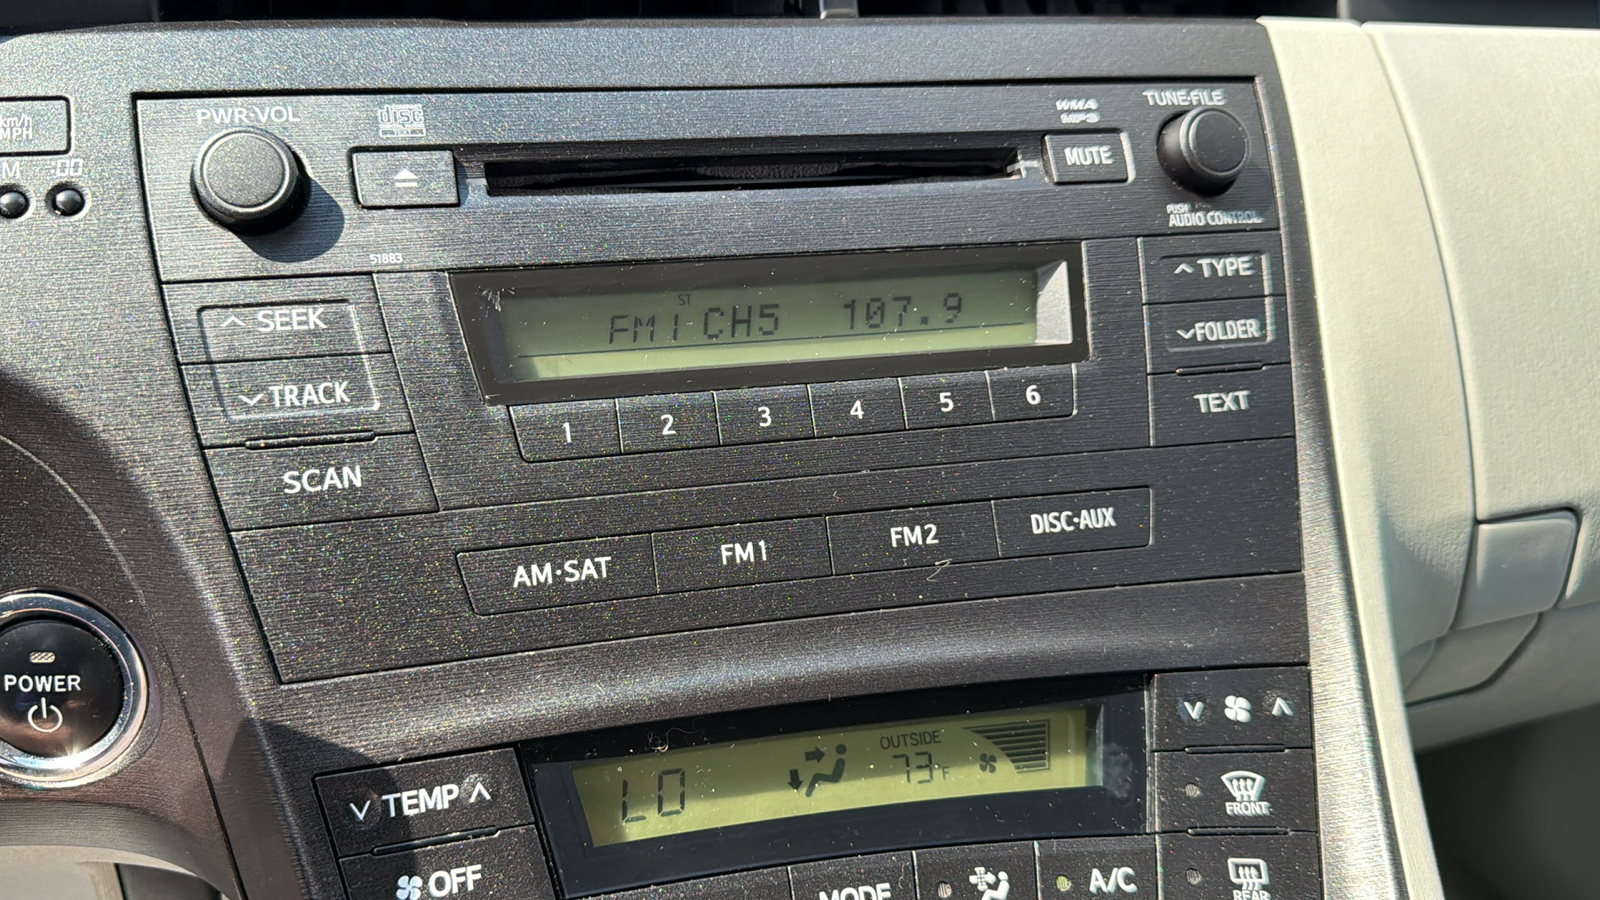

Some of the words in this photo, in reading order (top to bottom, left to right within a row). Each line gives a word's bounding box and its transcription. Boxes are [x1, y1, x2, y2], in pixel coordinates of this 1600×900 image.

[1064, 146, 1113, 165] MUTE
[1166, 203, 1191, 214] PUSH
[1169, 211, 1206, 227] AUDIO
[1207, 210, 1264, 225] CONTROL
[370, 252, 403, 263] 51883
[1197, 256, 1254, 277] TYPE
[678, 293, 692, 306] ST
[257, 307, 327, 331] SEEK
[703, 303, 780, 339] CH5
[1194, 319, 1261, 341] FOLDER
[269, 381, 350, 408] TRACK
[940, 392, 954, 412] 5
[1026, 386, 1041, 406] 6
[1193, 390, 1251, 413] TEXT
[757, 406, 772, 427] 3
[850, 399, 866, 420] 4
[562, 422, 573, 443] 1
[661, 414, 677, 435] 2
[283, 465, 362, 494] SCAN
[890, 524, 939, 548] FM2
[720, 541, 768, 565] FM1
[4, 674, 82, 692] POWER
[880, 730, 942, 750] OUTSIDE
[381, 784, 460, 818] TEMP
[1226, 802, 1270, 816] FRONT
[429, 865, 482, 898] OFF
[1089, 867, 1138, 894] A/C
[1233, 889, 1271, 900] REAR
